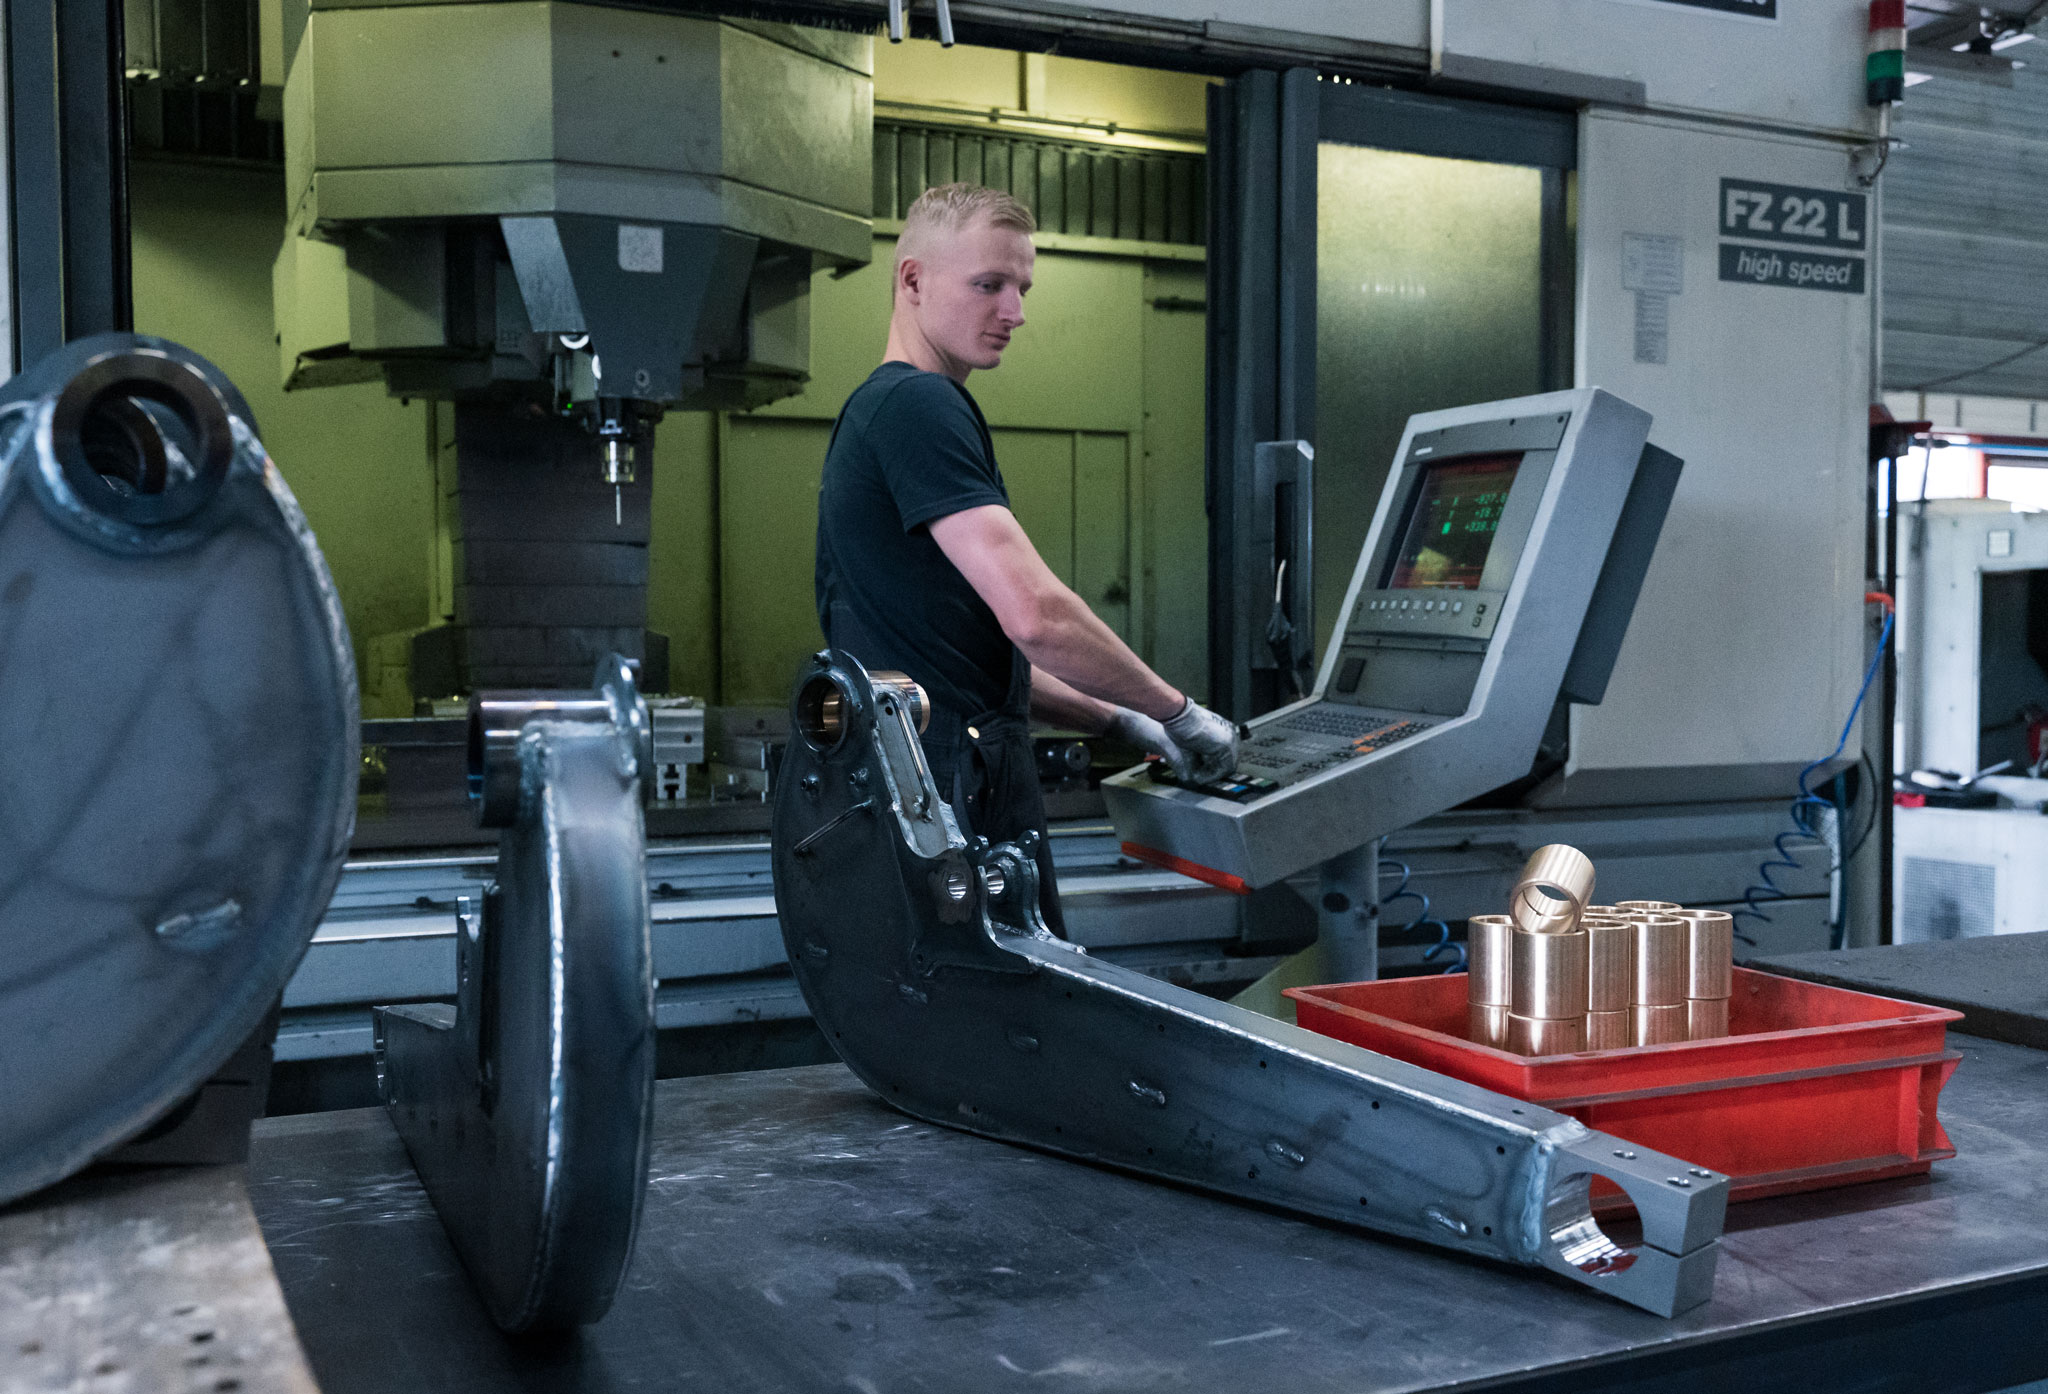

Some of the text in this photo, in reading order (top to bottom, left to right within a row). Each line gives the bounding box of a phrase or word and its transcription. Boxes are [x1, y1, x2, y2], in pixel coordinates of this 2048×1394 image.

[1725, 187, 1861, 242] FZ 22 L
[1736, 250, 1852, 285] high speed
